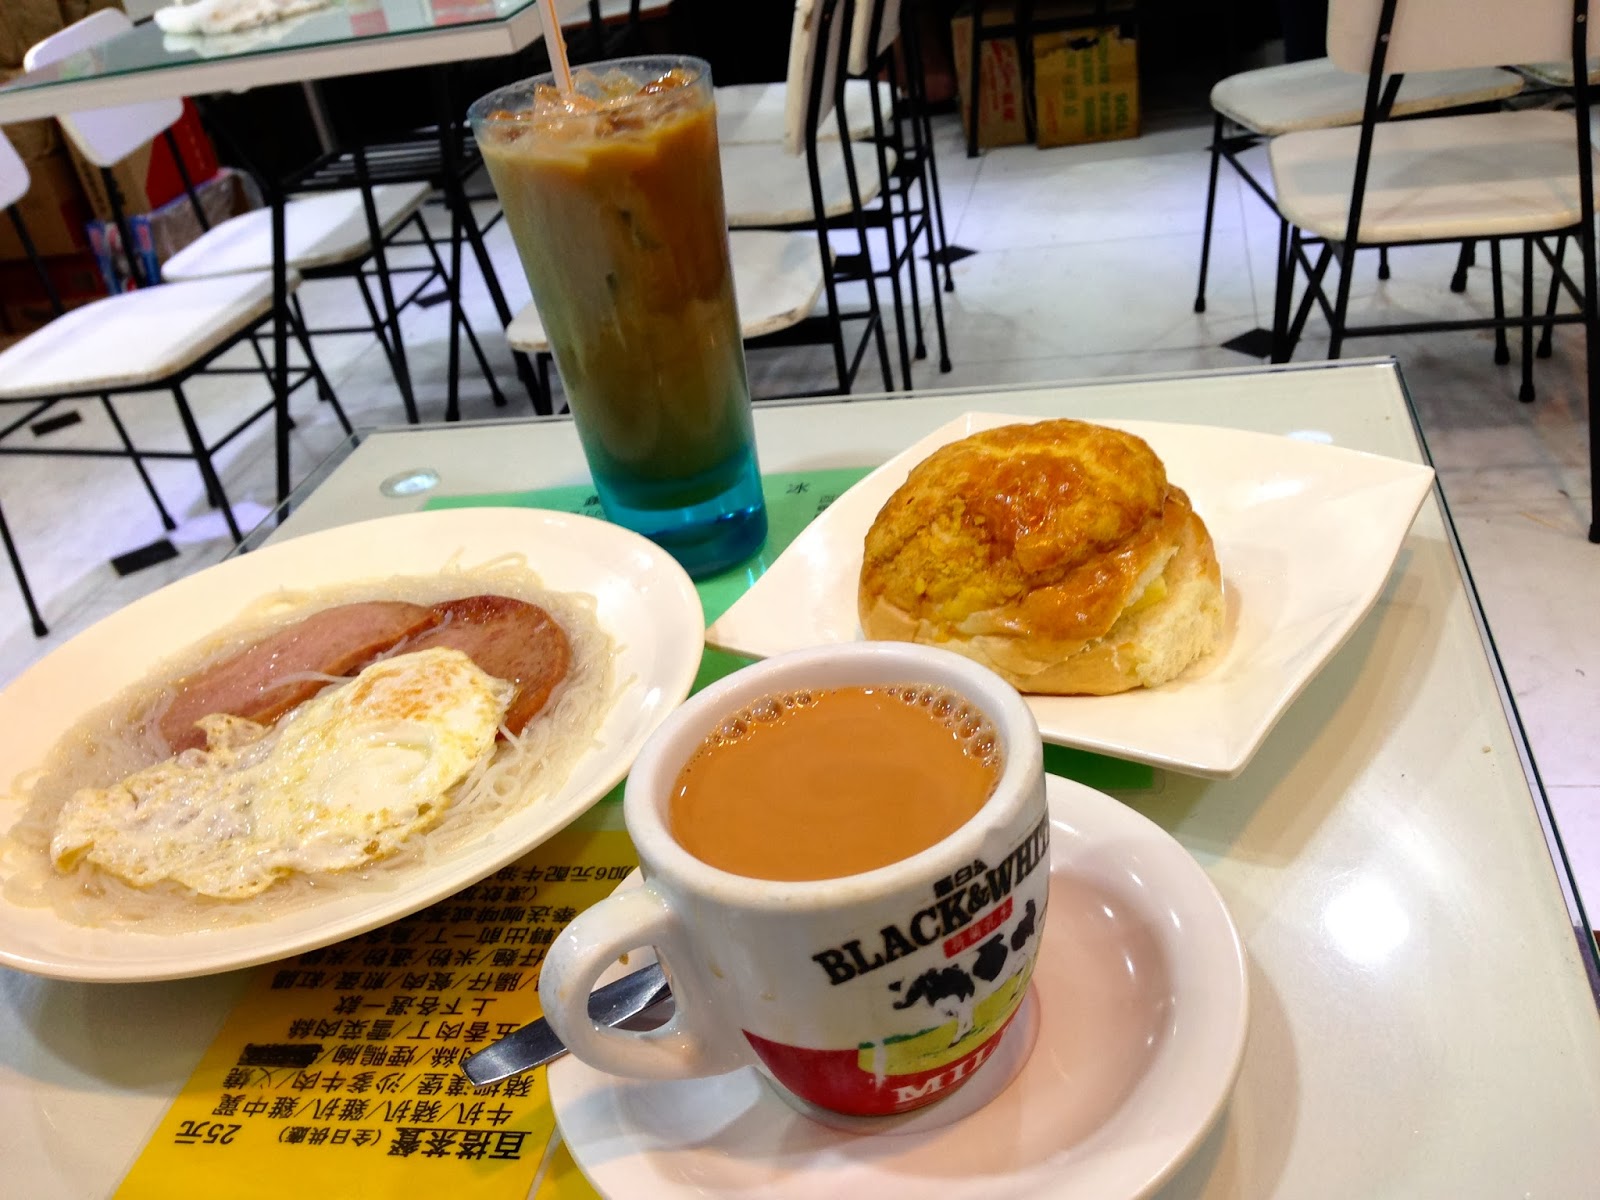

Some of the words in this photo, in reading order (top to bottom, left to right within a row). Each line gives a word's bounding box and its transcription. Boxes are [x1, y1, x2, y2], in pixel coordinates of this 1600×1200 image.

[812, 817, 1049, 986] BLACK&WHIT
[333, 994, 498, 1017] 上下各選一款
[891, 1044, 998, 1103] MIL
[174, 1121, 244, 1147] 25元
[388, 1128, 533, 1161] 百搭茶餐
